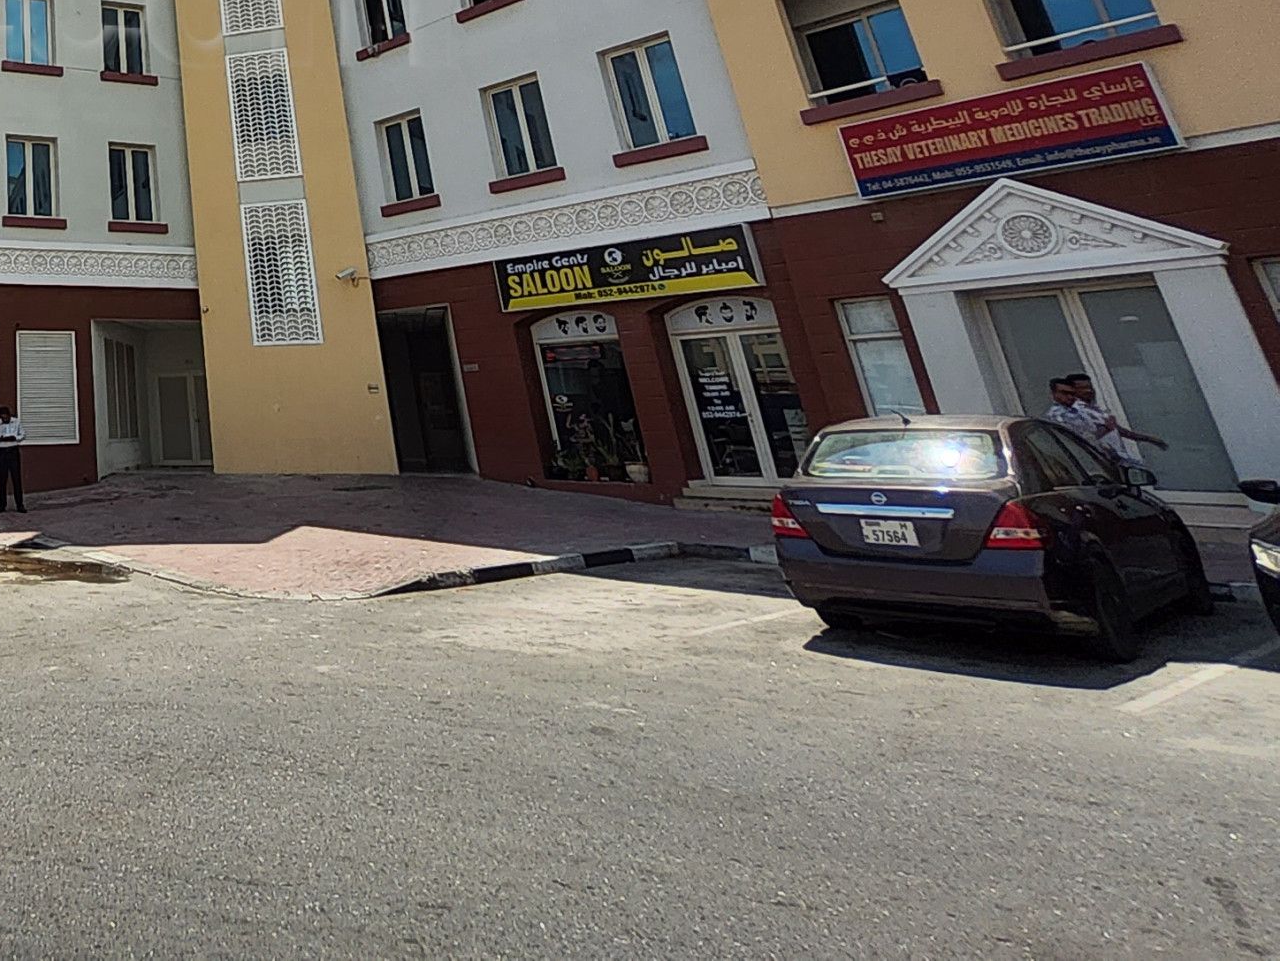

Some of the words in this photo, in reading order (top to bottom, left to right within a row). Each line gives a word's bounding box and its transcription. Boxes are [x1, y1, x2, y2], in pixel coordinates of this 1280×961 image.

[1139, 115, 1163, 129] LLC
[853, 142, 904, 170] THESAY
[904, 126, 991, 161] VETERINARY
[989, 112, 1078, 146] MEDICINES
[1078, 96, 1158, 129] TRADING
[641, 236, 738, 267] صالون
[506, 256, 551, 275] Empire
[552, 252, 588, 269] Gents
[600, 263, 632, 274] SALOON
[649, 261, 697, 281] للرجال
[507, 265, 593, 298] SALOON
[872, 529, 908, 544] 57564
